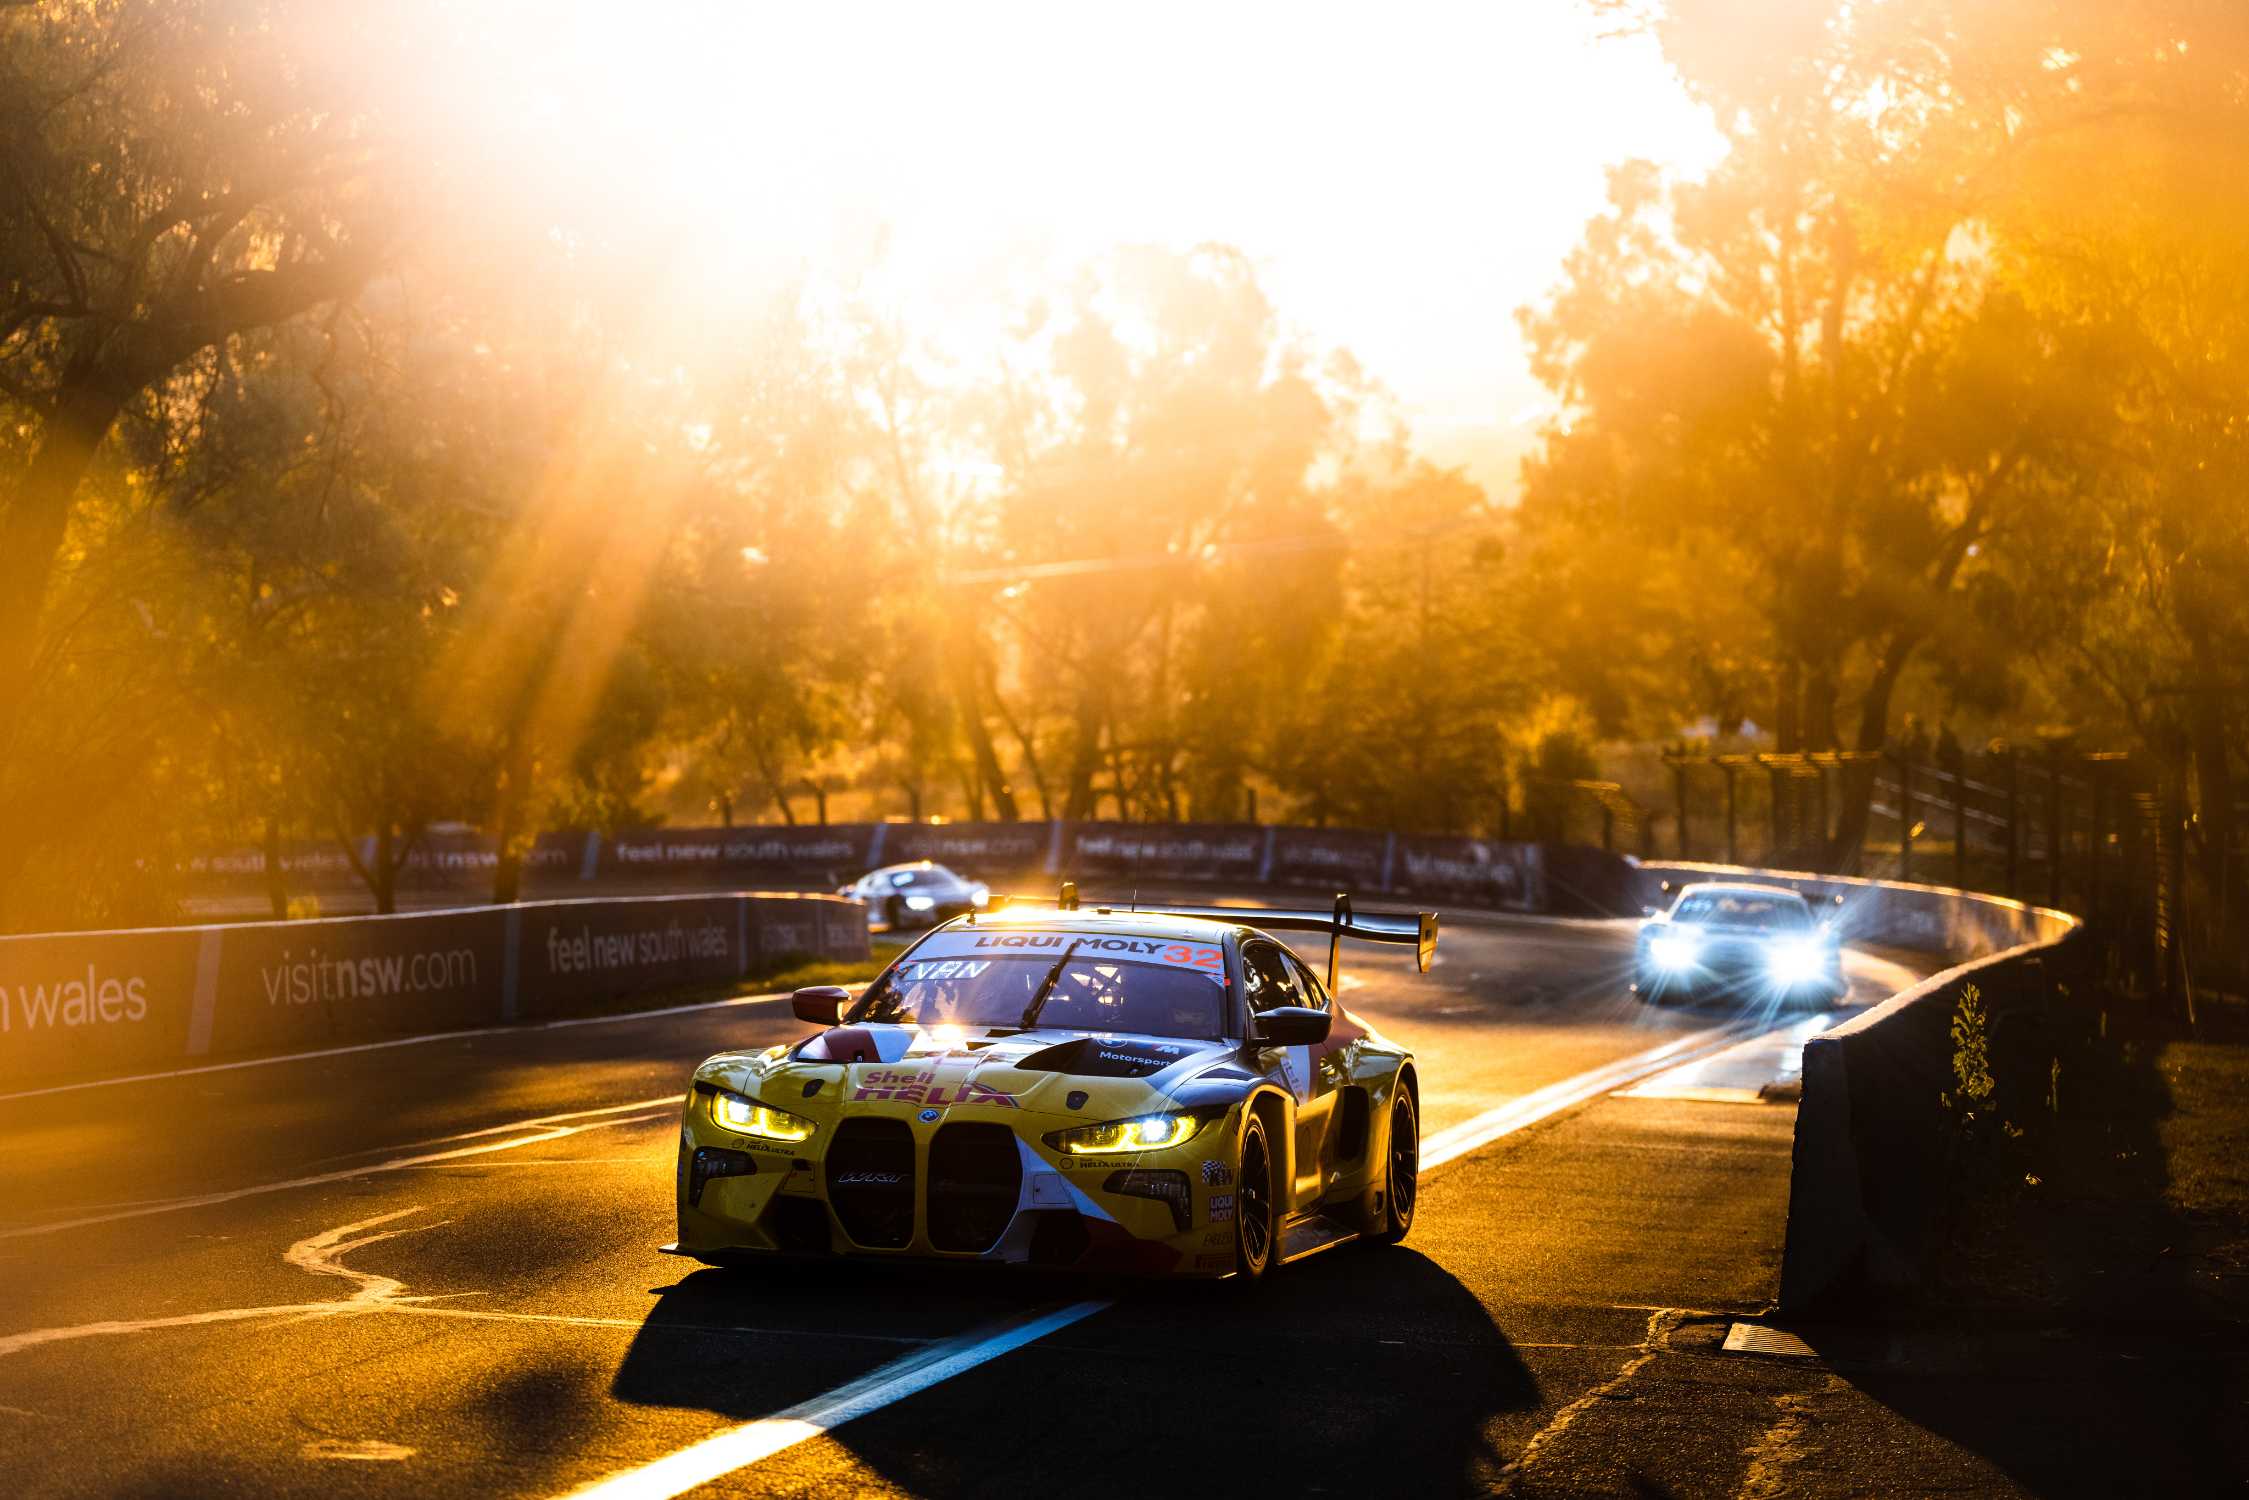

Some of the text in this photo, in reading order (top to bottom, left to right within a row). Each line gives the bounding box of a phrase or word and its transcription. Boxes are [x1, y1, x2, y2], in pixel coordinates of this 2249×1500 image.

[617, 840, 853, 861] feel new south wales
[547, 925, 591, 974] feel
[593, 933, 635, 969] new
[638, 919, 687, 965] south
[687, 915, 729, 959] wales
[975, 936, 1223, 969] LIQUI MOLY 32
[260, 948, 477, 1006] visitnsw.com
[918, 961, 991, 979] VAN
[18, 961, 147, 1030] wales
[1099, 1051, 1172, 1067] Motorsport
[864, 1071, 936, 1085] Shell
[854, 1084, 1018, 1108] HELIX
[1210, 1196, 1233, 1208] LIQUI
[1210, 1208, 1233, 1222] MOLY
